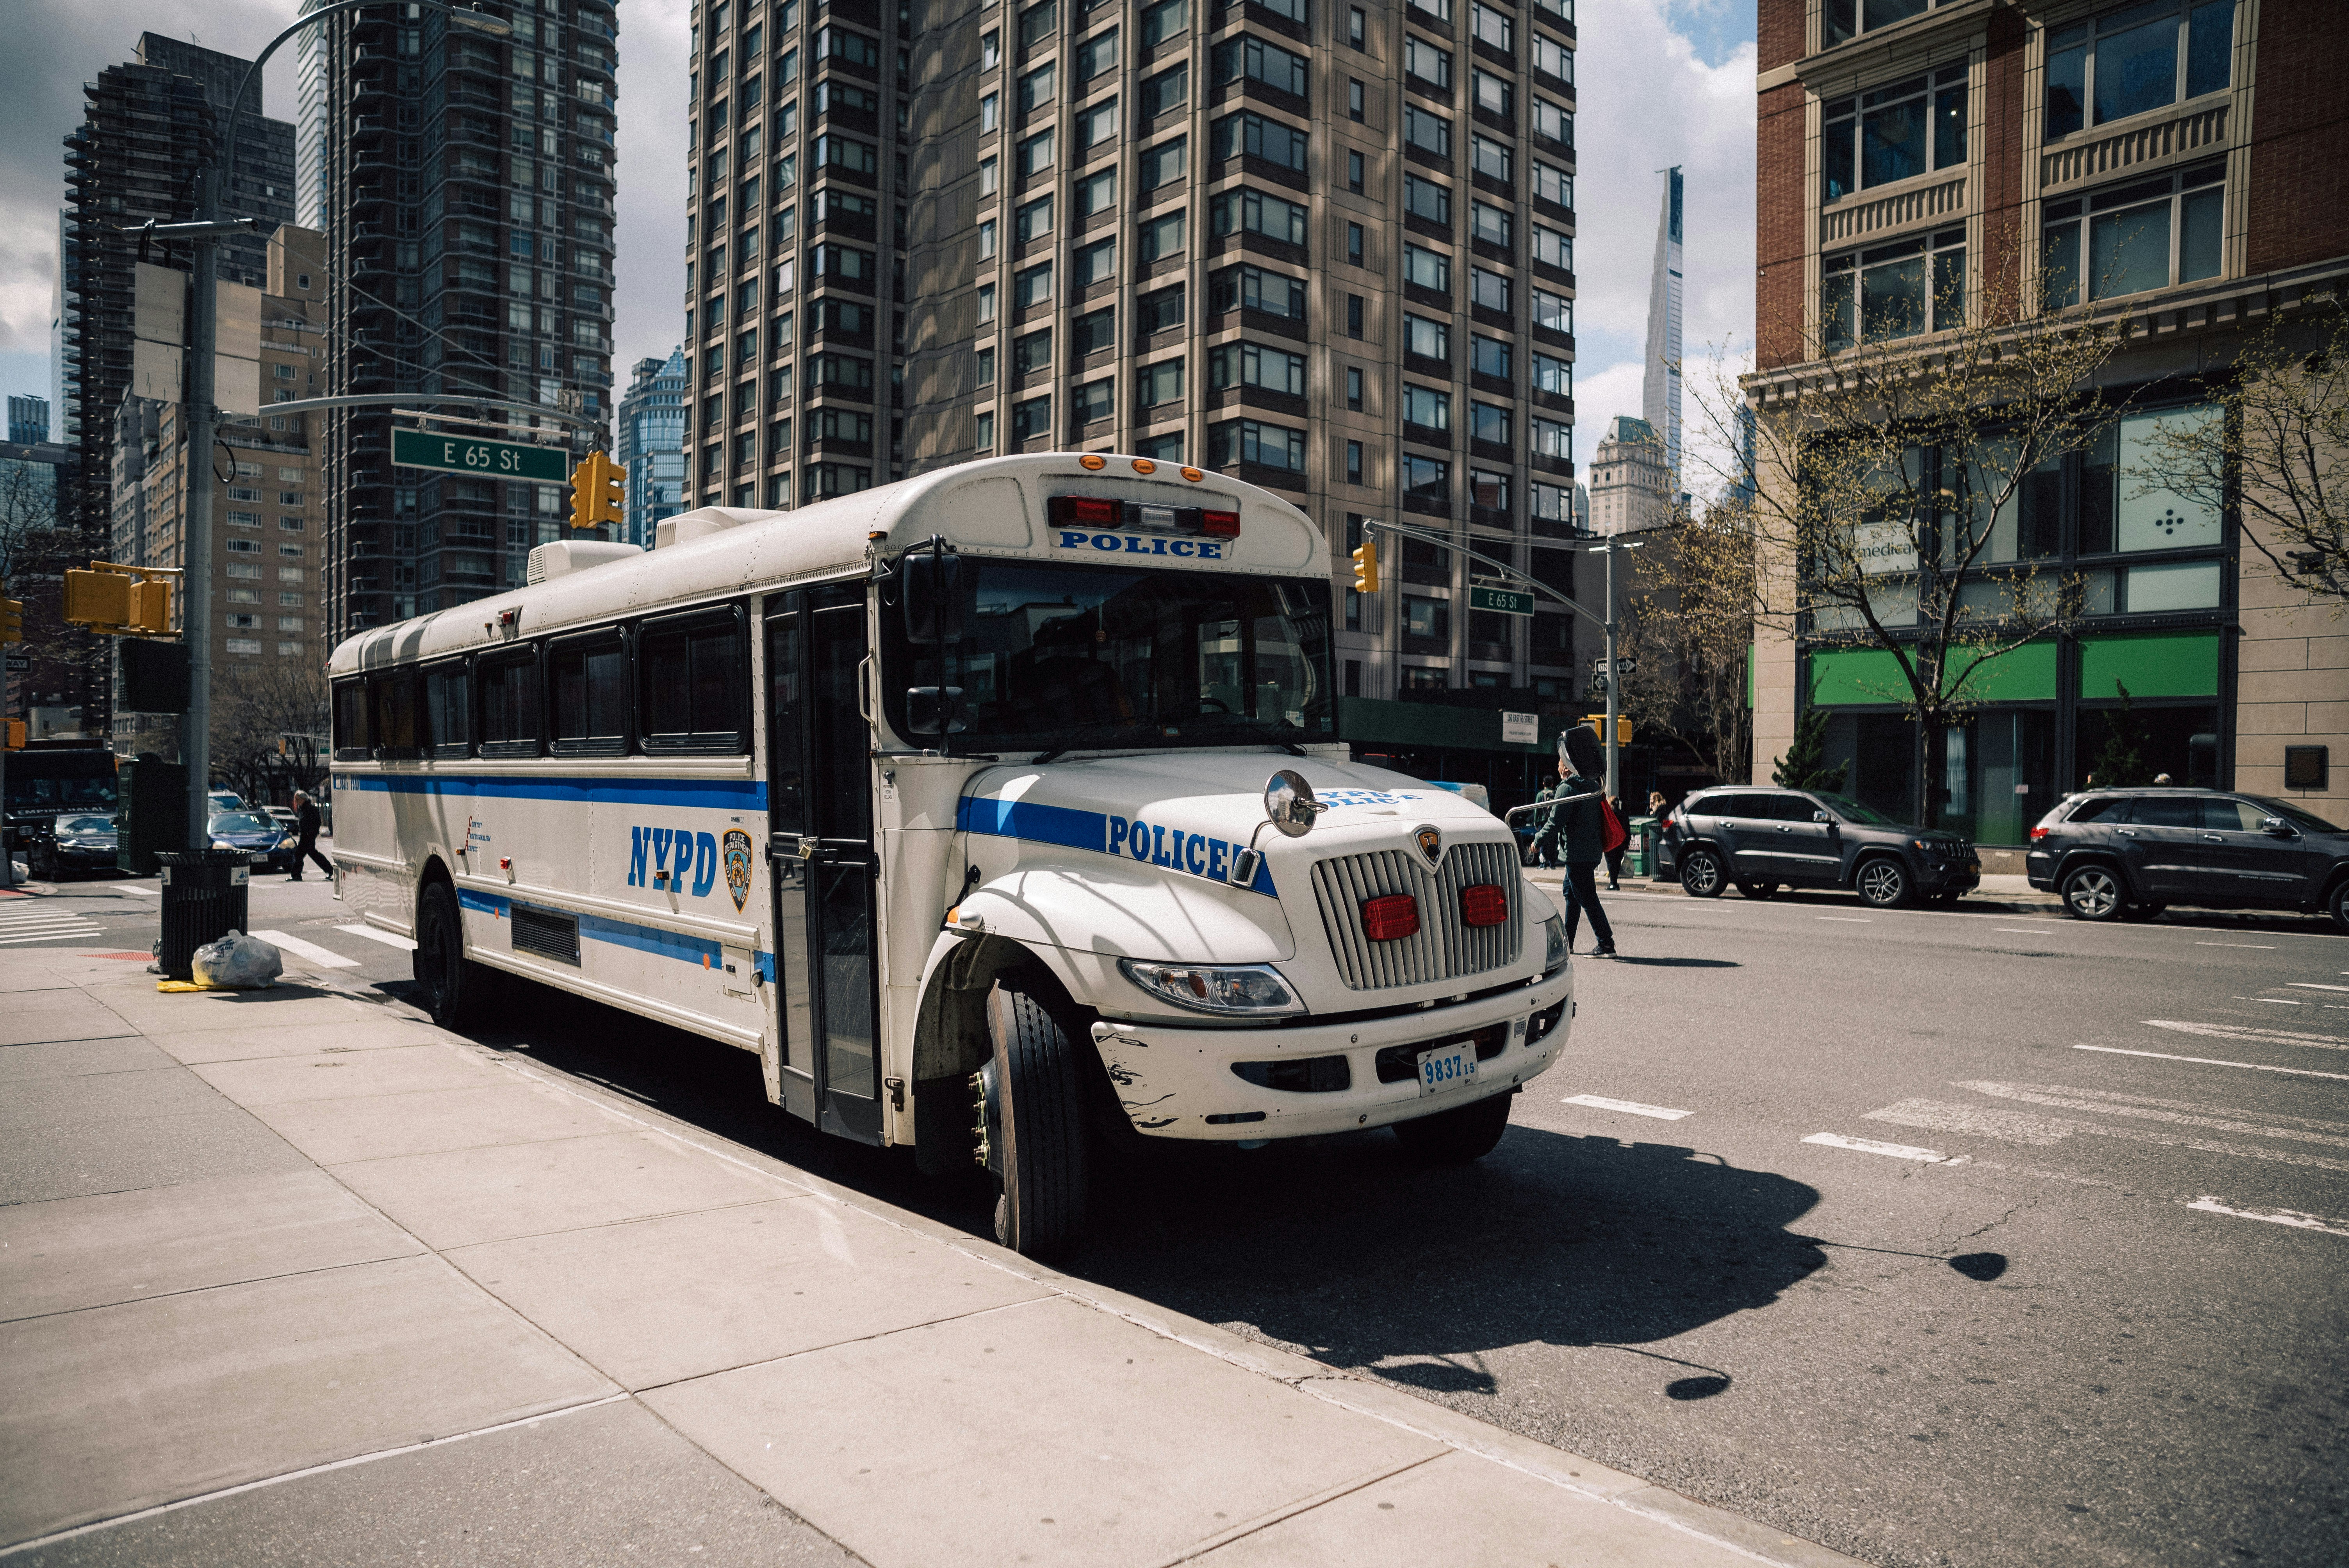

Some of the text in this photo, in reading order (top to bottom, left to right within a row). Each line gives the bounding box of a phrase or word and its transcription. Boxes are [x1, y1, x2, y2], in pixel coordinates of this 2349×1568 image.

[444, 442, 520, 471] E 65 St
[1059, 531, 1222, 559] POLICE
[1489, 593, 1517, 609] E 65 St
[1524, 715, 1535, 724] STREET
[1315, 791, 1392, 801] YPD
[1317, 795, 1424, 808] OLICE
[729, 832, 745, 844] POLICE
[724, 841, 751, 858] DEPARTMENT
[1109, 815, 1228, 882] POLICE
[627, 826, 717, 897] NYPD
[731, 887, 737, 898] OF
[1425, 1055, 1475, 1084] 9837 15
